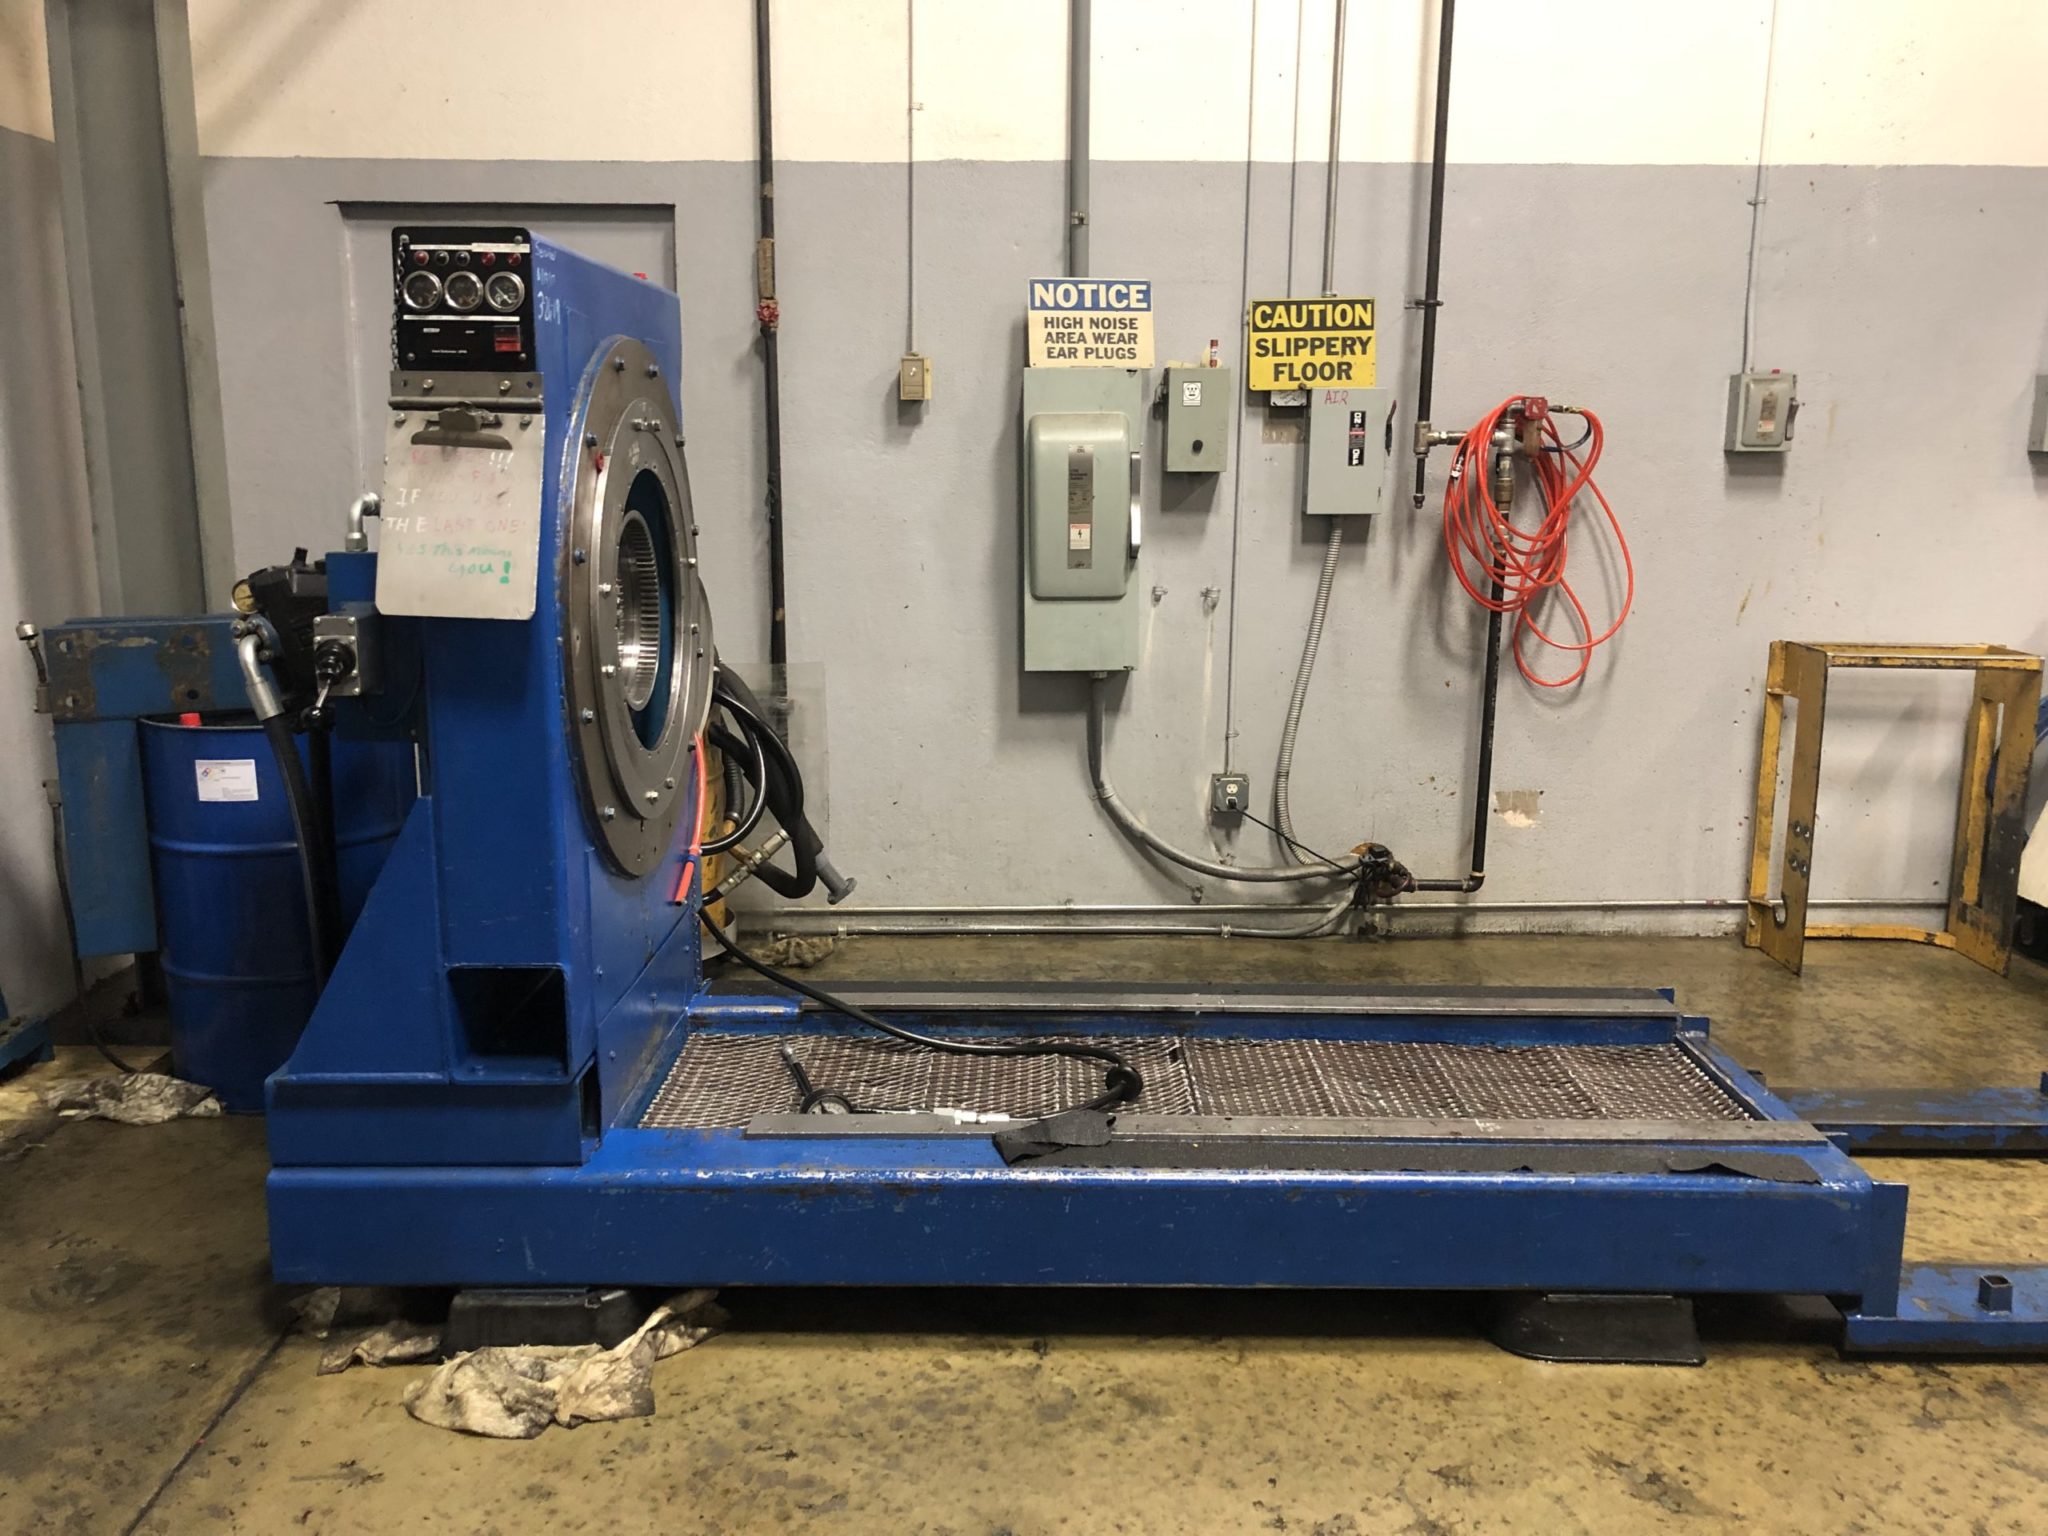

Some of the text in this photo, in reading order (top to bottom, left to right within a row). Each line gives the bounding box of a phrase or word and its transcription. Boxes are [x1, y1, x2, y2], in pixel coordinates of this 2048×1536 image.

[1034, 283, 1148, 308] NOTICE
[1044, 317, 1139, 330] HIGH NOISE
[1254, 303, 1372, 329] CAUTION
[1044, 332, 1138, 345] AREA WEAR
[1255, 336, 1372, 358] SLIPPERY
[1047, 347, 1137, 360] EAR PLUGS
[1273, 361, 1353, 382] FLOOR
[1324, 389, 1349, 405] AIR
[396, 488, 421, 508] IF
[385, 516, 428, 534] THE
